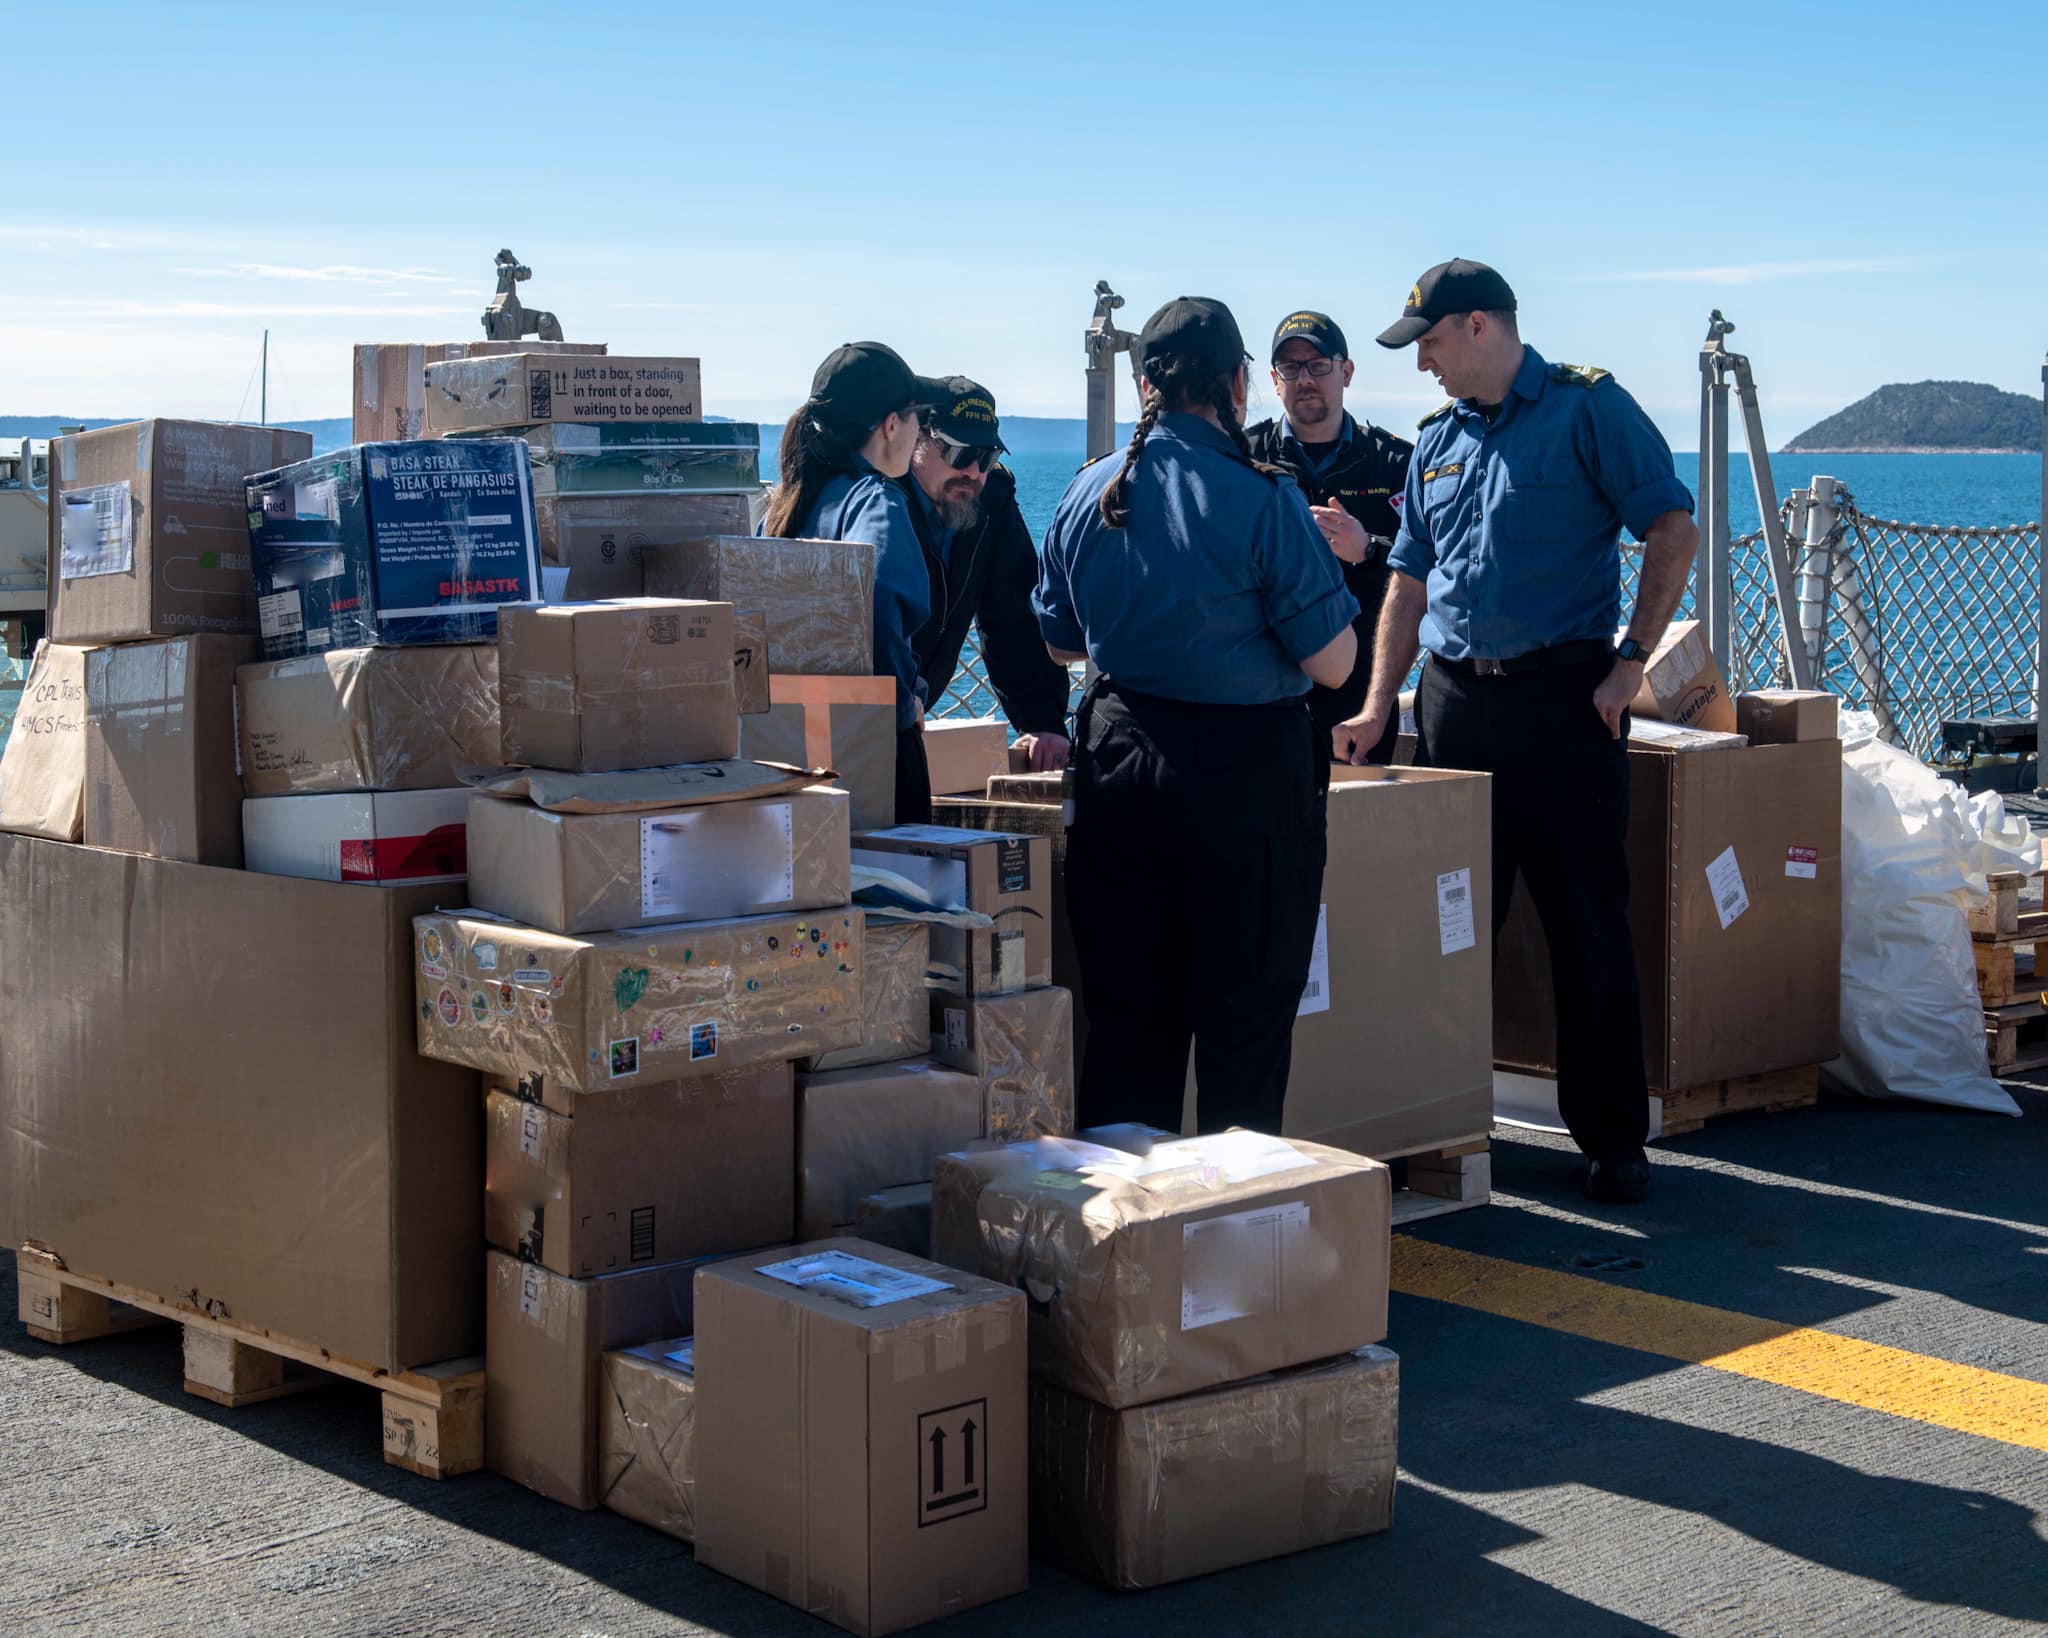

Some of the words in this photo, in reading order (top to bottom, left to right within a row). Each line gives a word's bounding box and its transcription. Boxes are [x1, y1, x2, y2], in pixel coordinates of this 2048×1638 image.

[573, 367, 596, 380] Just
[600, 369, 607, 379] a
[610, 367, 633, 383] box,
[635, 367, 684, 383] standing
[574, 384, 584, 398] in
[588, 384, 617, 398] front
[620, 385, 633, 398] of
[635, 388, 642, 398] a
[645, 385, 673, 401] door,
[574, 403, 617, 418] waiting
[620, 404, 632, 416] to
[635, 403, 649, 416] be
[652, 403, 693, 418] opened
[176, 429, 208, 442] More
[165, 457, 192, 472] Way
[193, 462, 207, 472] to
[391, 457, 422, 471] BASA
[425, 455, 460, 469] STEAK
[394, 476, 429, 490] STEAK
[434, 475, 447, 489] DE
[452, 473, 515, 488] PANGASIUS
[644, 475, 660, 484] Bos
[439, 578, 520, 596] BASASTK
[160, 613, 198, 626] 100%
[36, 684, 58, 703] CPL
